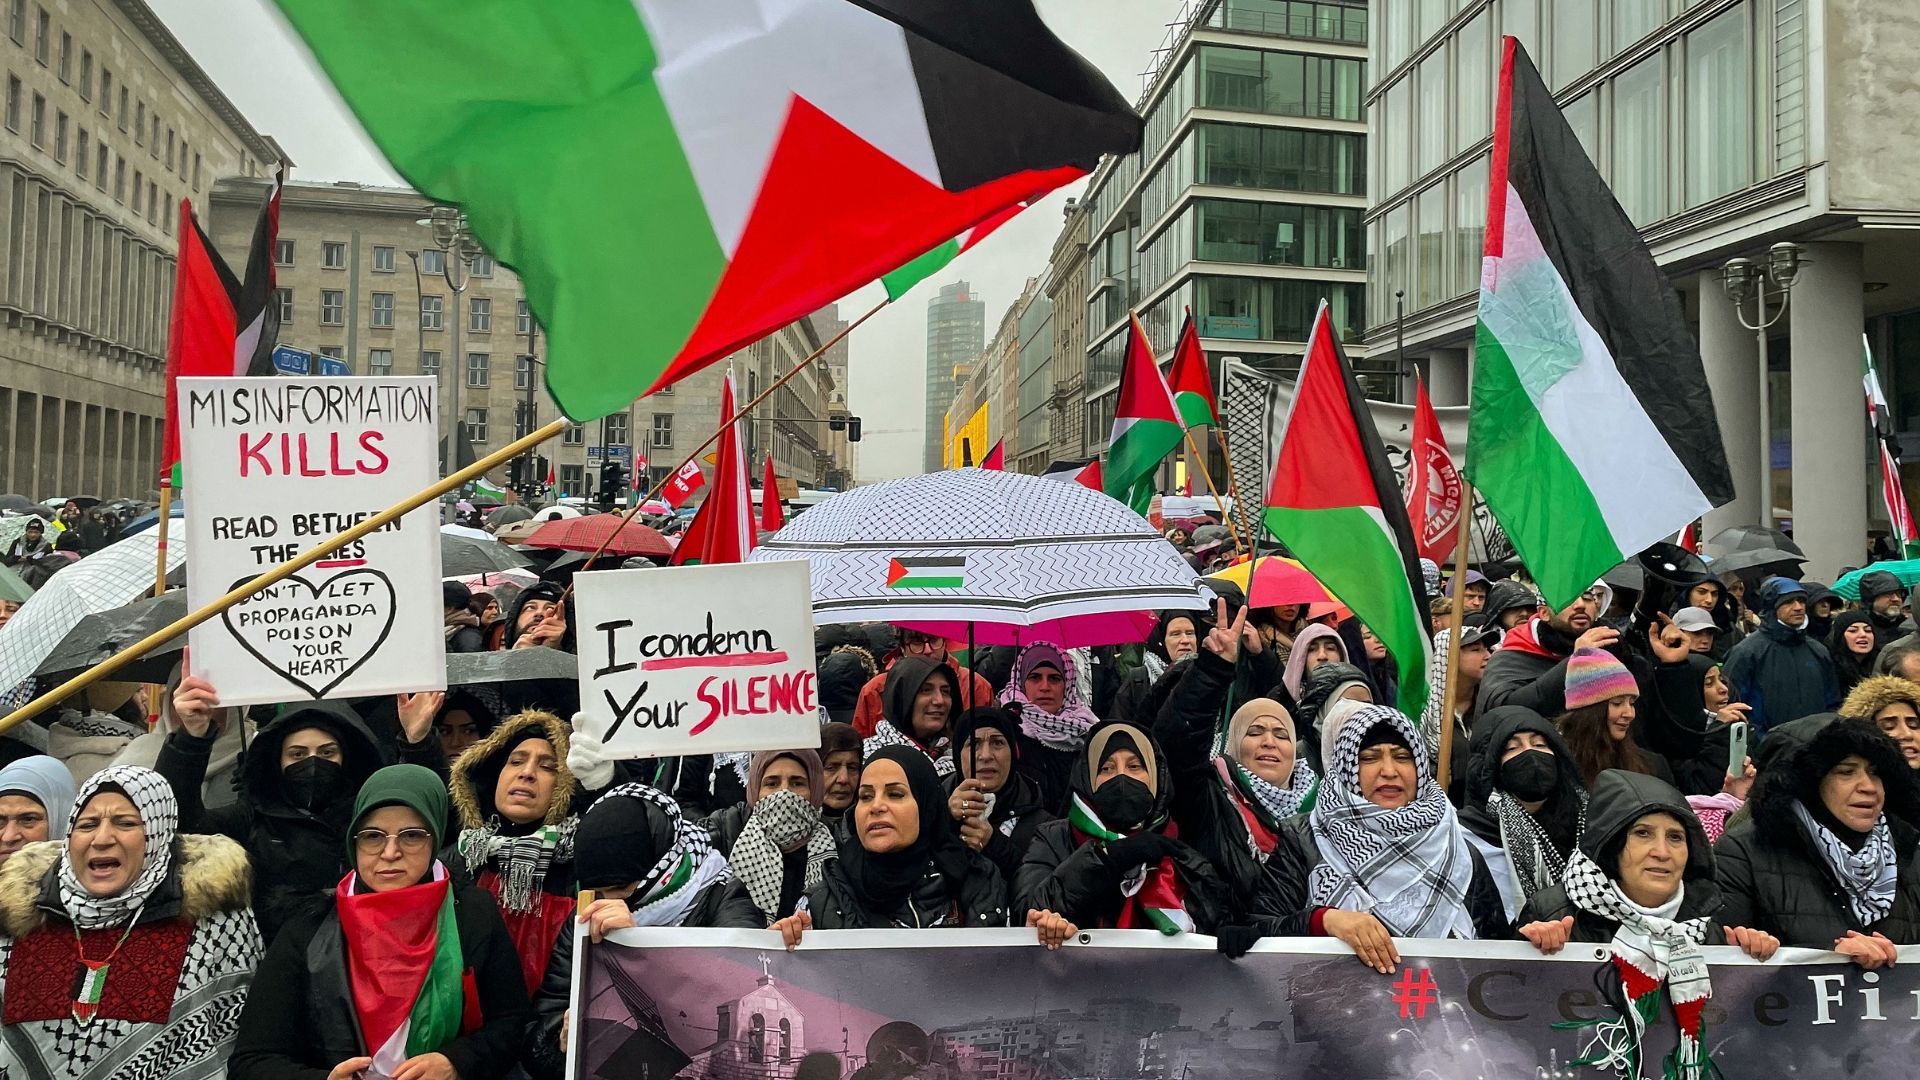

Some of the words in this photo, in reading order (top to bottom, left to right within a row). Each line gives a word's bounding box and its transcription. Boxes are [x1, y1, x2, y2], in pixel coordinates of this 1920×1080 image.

[190, 385, 432, 428] MISINFORMATION
[239, 431, 389, 477] KILLS
[212, 515, 278, 540] READ
[250, 543, 299, 565] THE
[238, 584, 302, 606] ON'T
[328, 582, 375, 598] LET
[239, 603, 377, 627] PROPAGANDA
[266, 622, 353, 642] POISON
[292, 640, 343, 657] YOUR
[593, 619, 637, 680] I
[639, 611, 778, 658] condemn
[288, 657, 349, 676] HEART
[601, 681, 688, 744] Your
[689, 669, 816, 737] SILENCE
